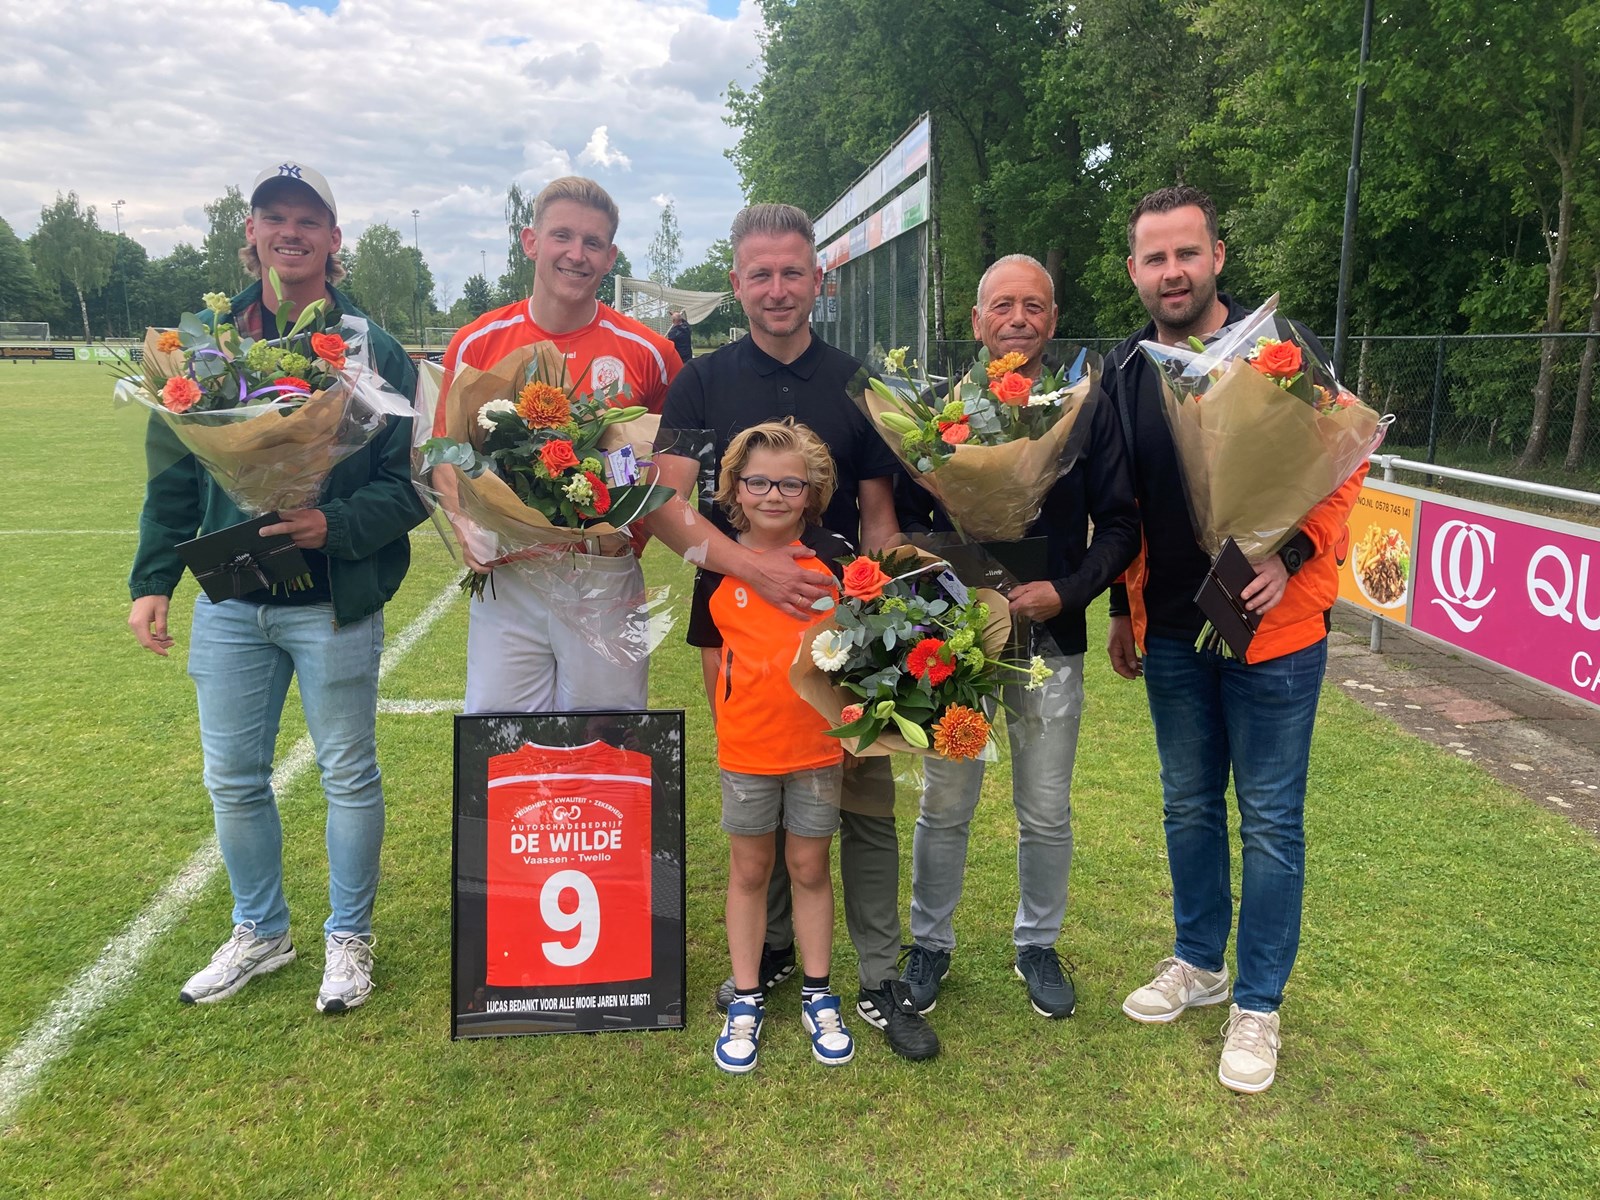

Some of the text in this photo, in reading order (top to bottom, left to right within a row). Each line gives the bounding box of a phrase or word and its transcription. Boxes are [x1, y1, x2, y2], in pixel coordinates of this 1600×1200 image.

[278, 163, 303, 179] NY
[1375, 500, 1389, 512] 0578
[1390, 504, 1401, 515] 745
[1402, 506, 1411, 517] 141
[735, 587, 748, 608] 9
[514, 800, 547, 819] VEILIGHEID
[554, 796, 587, 804] KWALITEIT
[594, 800, 624, 819] ZEKERHEID
[511, 820, 622, 832] AUTOSCHADEBEDRIJF
[510, 829, 622, 854] DE WILDE
[523, 855, 568, 865] Vaassen
[578, 852, 612, 863] Twello
[539, 869, 601, 967] 9
[486, 1000, 509, 1013] LUCAS
[509, 998, 539, 1012] BEDANKT
[540, 997, 558, 1011] VOOR
[559, 996, 575, 1010] ALLE
[575, 995, 597, 1009] MOOIE
[597, 994, 618, 1008] JAREN
